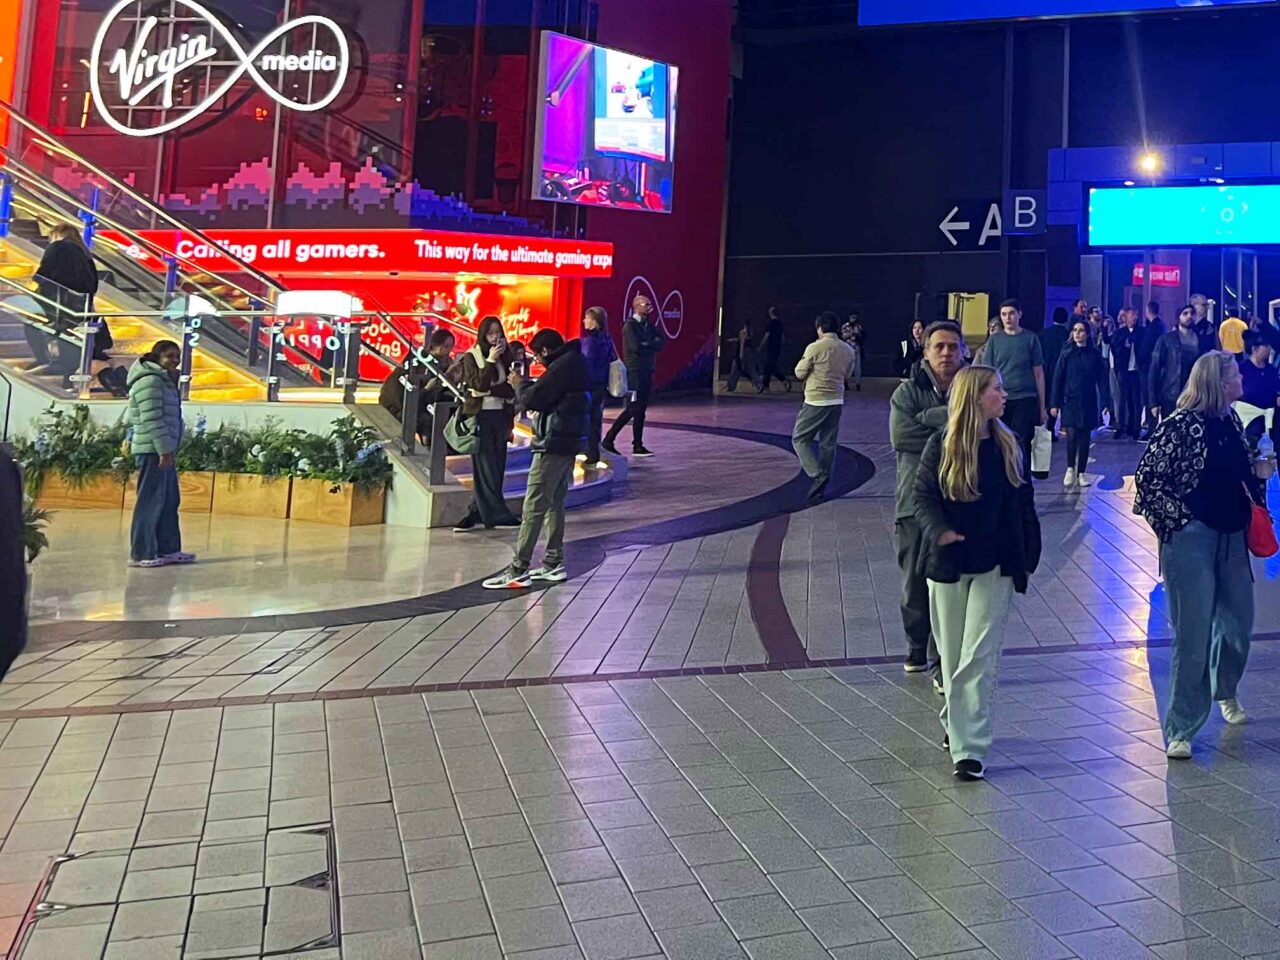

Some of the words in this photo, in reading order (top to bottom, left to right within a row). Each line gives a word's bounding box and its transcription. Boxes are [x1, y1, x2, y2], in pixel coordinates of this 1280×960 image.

[110, 15, 217, 109] Virgin
[261, 50, 337, 72] media
[978, 203, 1002, 246] A
[1014, 196, 1037, 228] B
[262, 239, 290, 259] all
[295, 241, 386, 262] gamers.
[414, 239, 442, 259] This
[444, 245, 470, 263] way
[472, 243, 489, 261] for
[491, 243, 509, 262] the
[511, 245, 553, 264] ultimate
[555, 249, 591, 269] gaming
